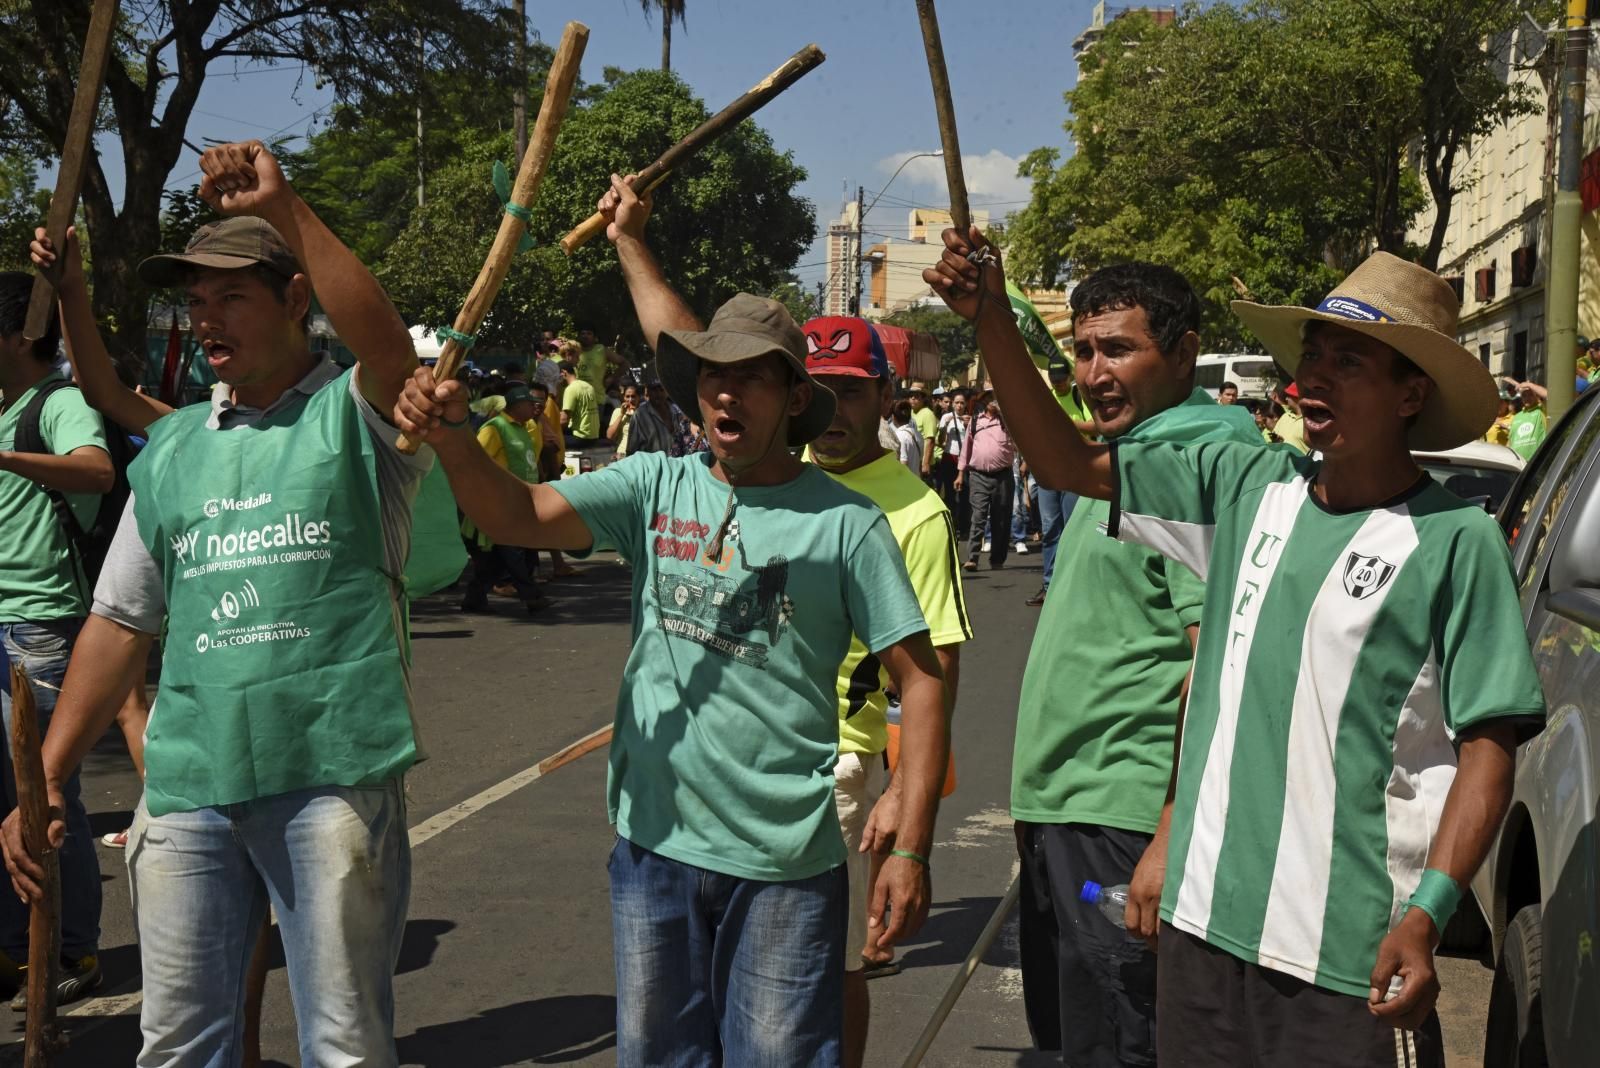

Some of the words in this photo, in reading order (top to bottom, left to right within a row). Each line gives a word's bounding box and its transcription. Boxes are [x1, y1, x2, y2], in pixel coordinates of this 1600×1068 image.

[221, 492, 272, 511] Medalla
[207, 513, 331, 557] notecalles
[207, 558, 246, 573] IMPUESTOS
[247, 555, 268, 567] PARA
[269, 553, 279, 564] LA
[1356, 568, 1372, 583] 20
[211, 639, 228, 649] Las
[229, 627, 311, 646] COOPERATIVAS
[217, 626, 246, 636] APOYAN
[247, 625, 256, 633] LA
[256, 621, 295, 632] INICIATIVA
